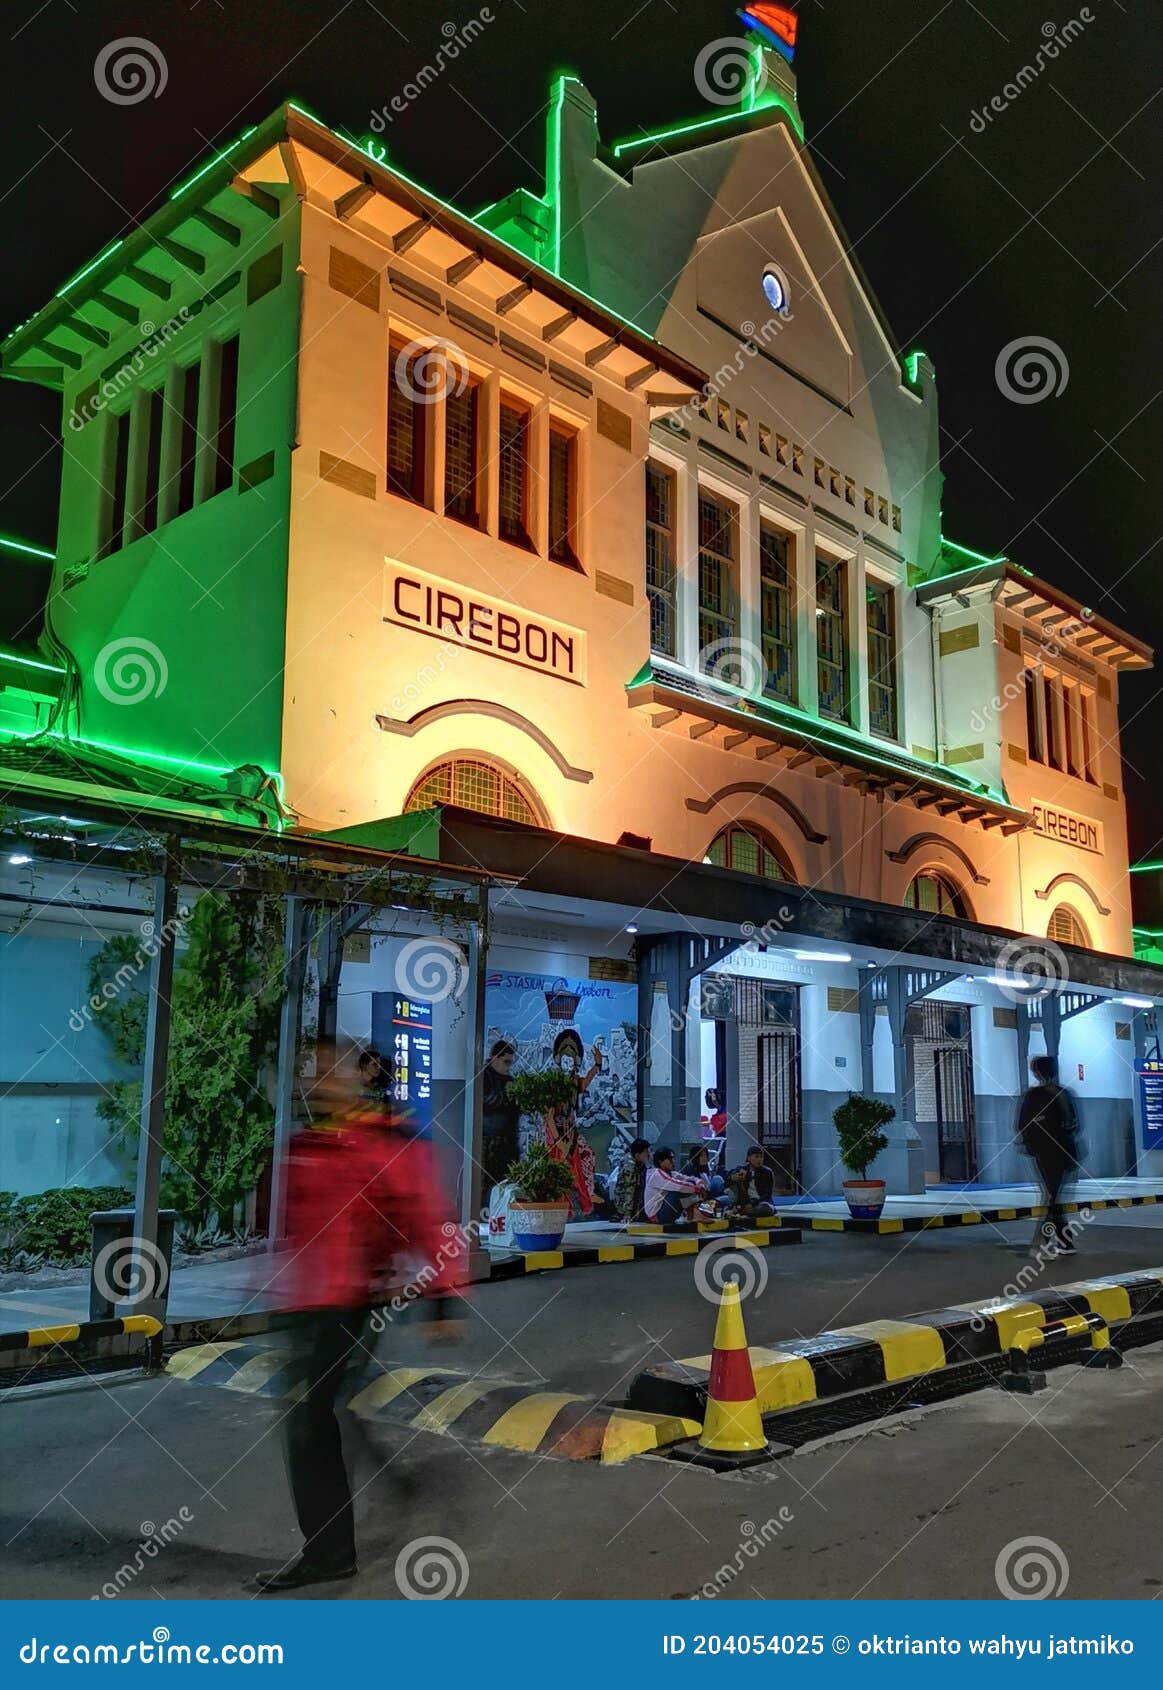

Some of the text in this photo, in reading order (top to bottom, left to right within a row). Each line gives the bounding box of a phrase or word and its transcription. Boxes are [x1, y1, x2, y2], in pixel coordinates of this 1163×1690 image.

[394, 576, 574, 674] CIREBON
[1033, 806, 1098, 849] CIREBON
[506, 975, 545, 991] STASIUN
